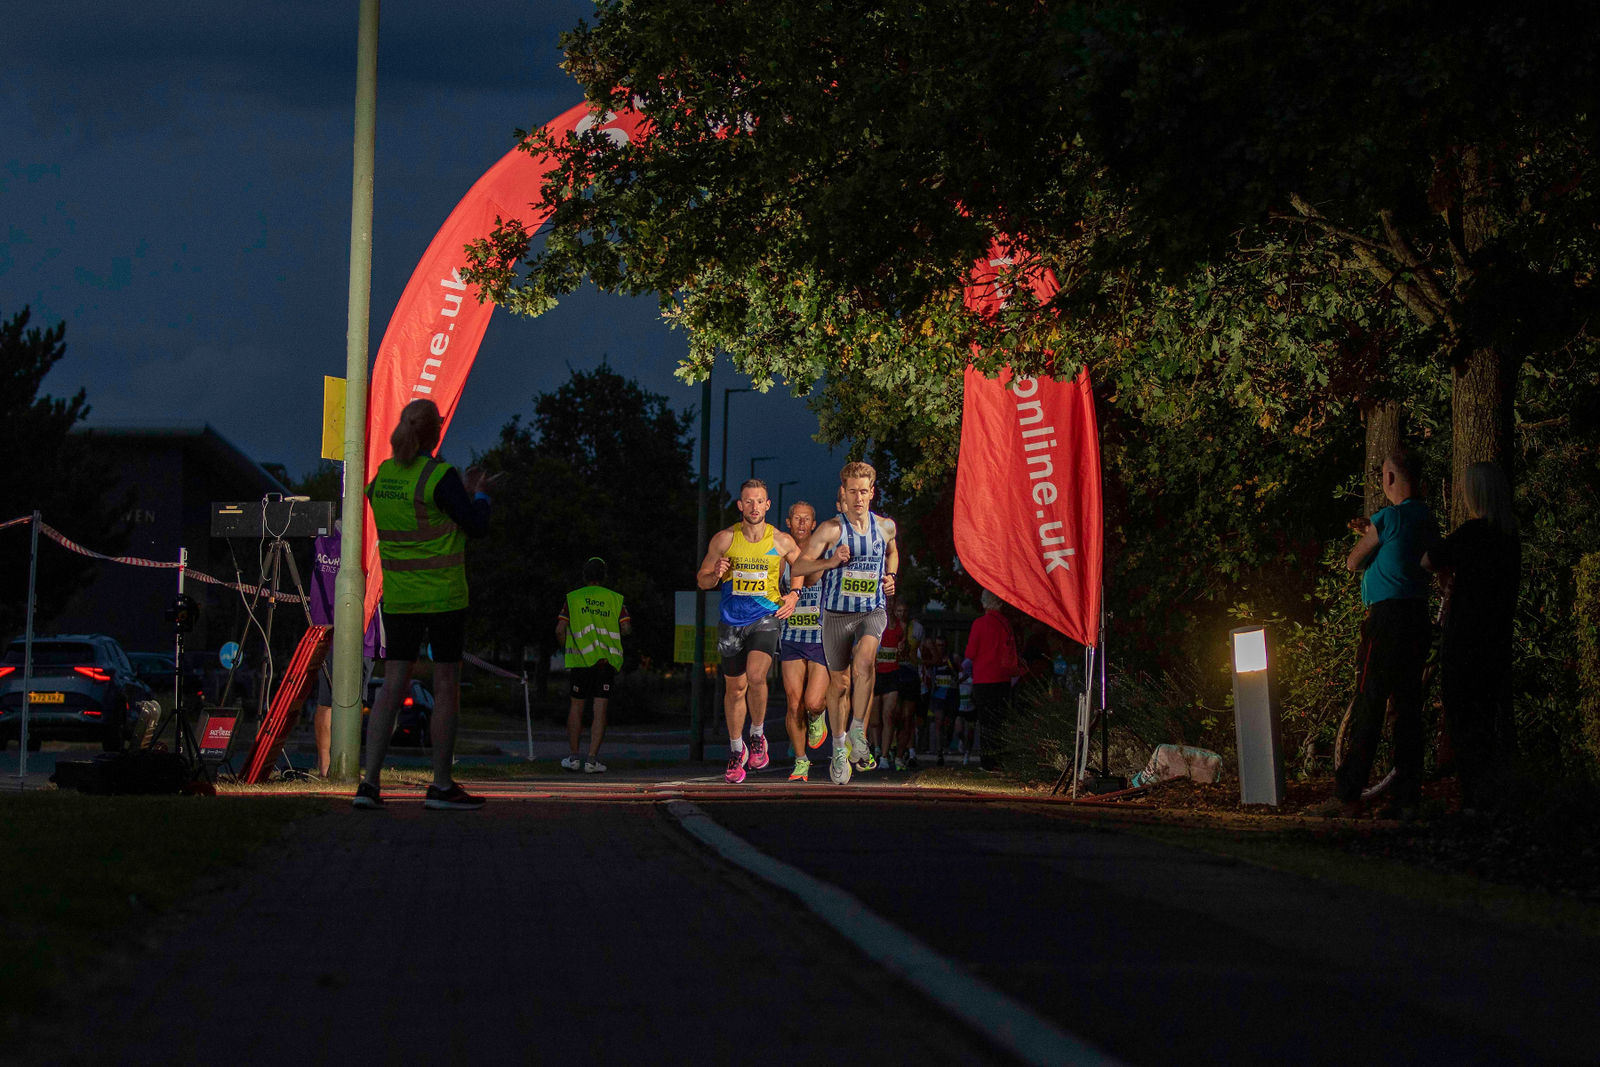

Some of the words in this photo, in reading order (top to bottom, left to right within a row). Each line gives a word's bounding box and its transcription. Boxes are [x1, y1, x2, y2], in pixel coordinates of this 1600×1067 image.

[411, 266, 469, 401] ine.uk
[735, 563, 769, 571] STRIDERS
[735, 579, 766, 592] 1773
[844, 579, 876, 593] 5692
[585, 597, 605, 607] Race
[789, 614, 818, 626] 5959
